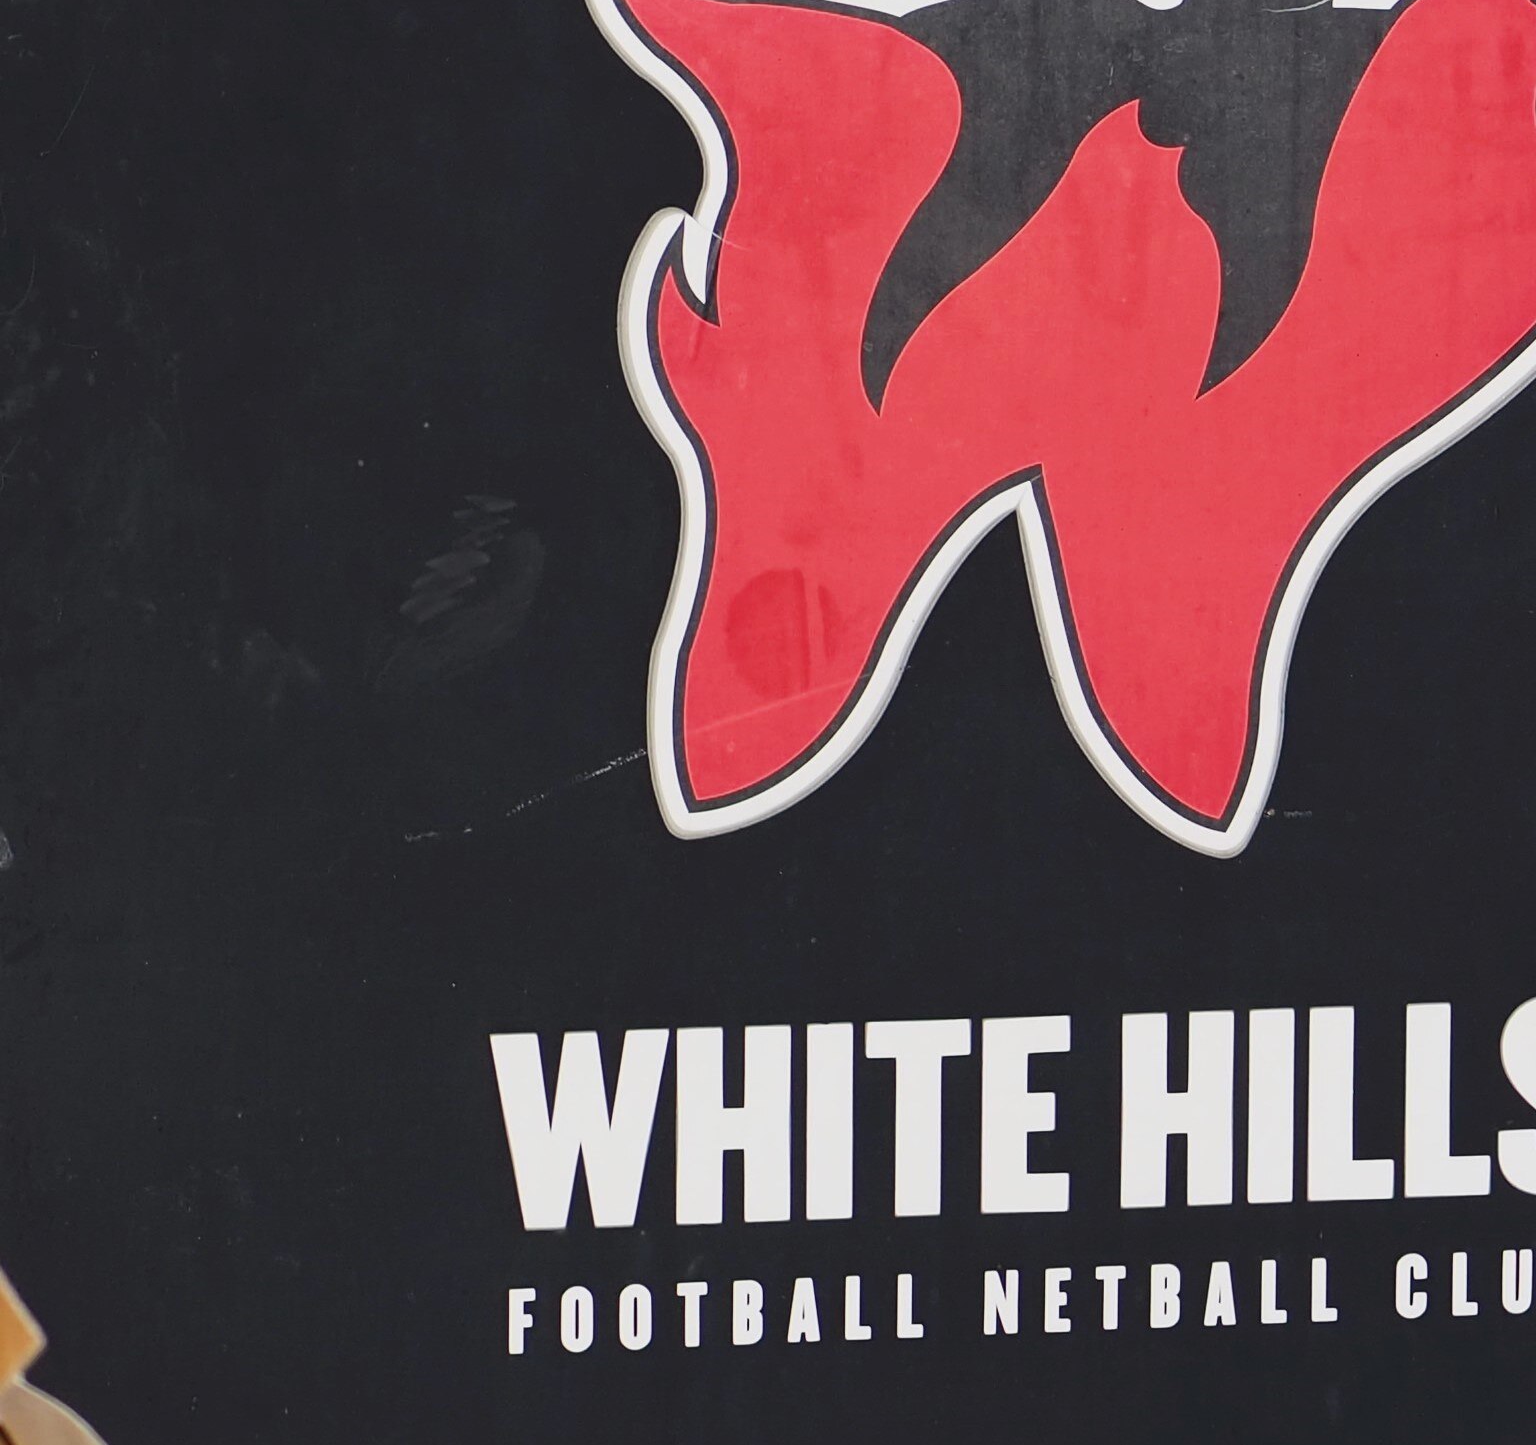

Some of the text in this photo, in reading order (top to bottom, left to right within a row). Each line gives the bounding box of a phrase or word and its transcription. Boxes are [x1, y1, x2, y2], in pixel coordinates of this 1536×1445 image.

[489, 1013, 1072, 1232] WHITE
[507, 1272, 925, 1355] FOOTBALL
[982, 1256, 1339, 1337] NETBALL
